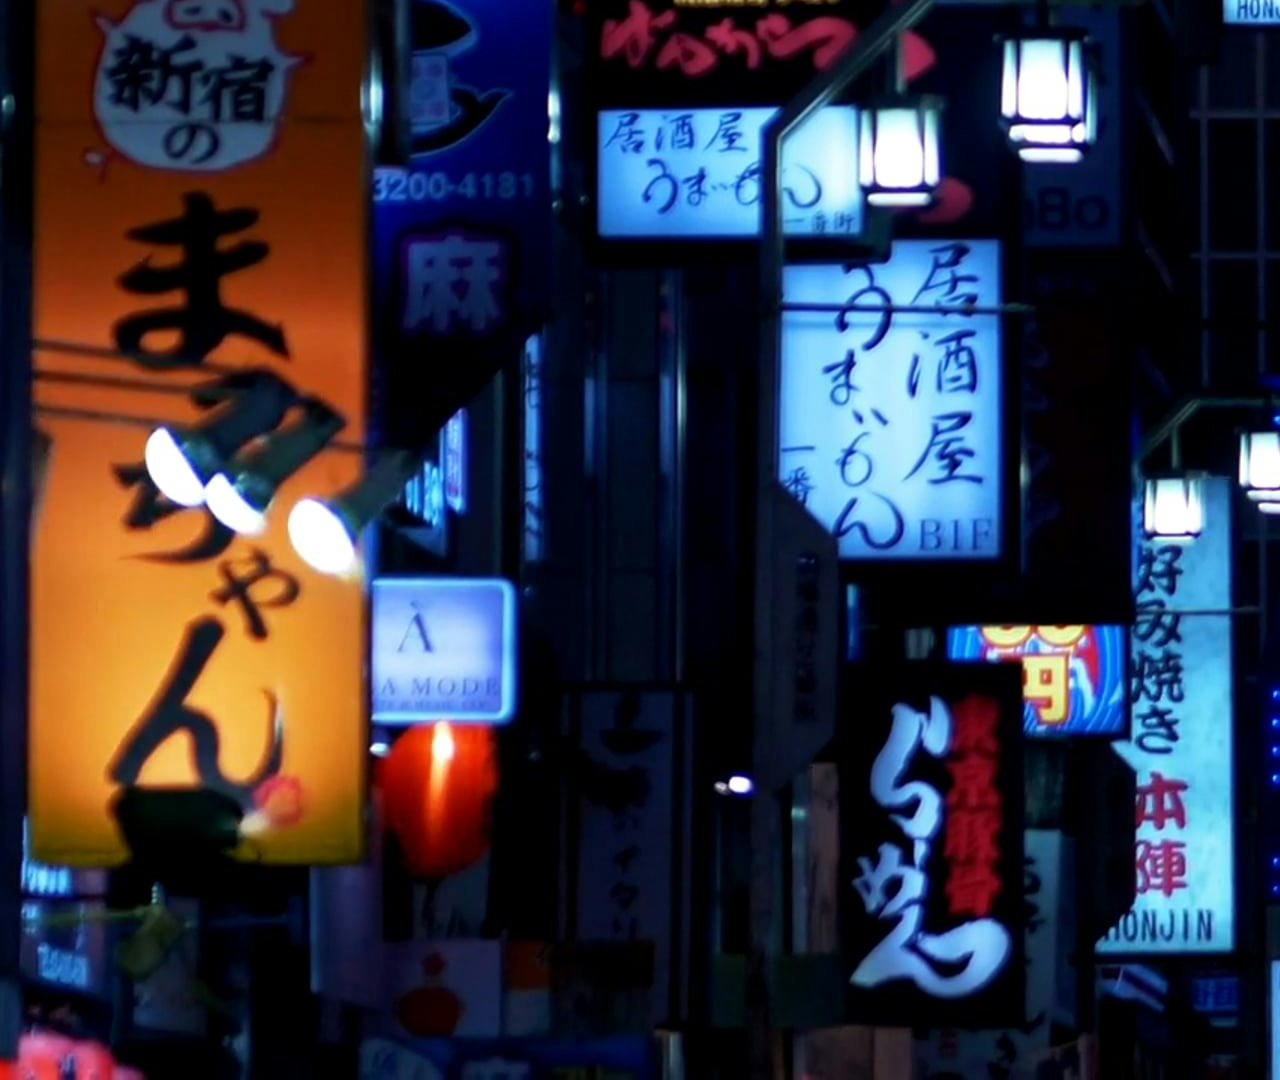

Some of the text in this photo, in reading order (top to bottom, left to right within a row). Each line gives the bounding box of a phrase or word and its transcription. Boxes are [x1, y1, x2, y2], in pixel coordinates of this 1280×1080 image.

[603, 111, 749, 156] 居酒屋
[822, 263, 904, 551] うまいもん
[902, 241, 984, 488] 居酒屋
[1136, 772, 1189, 899] 本陣
